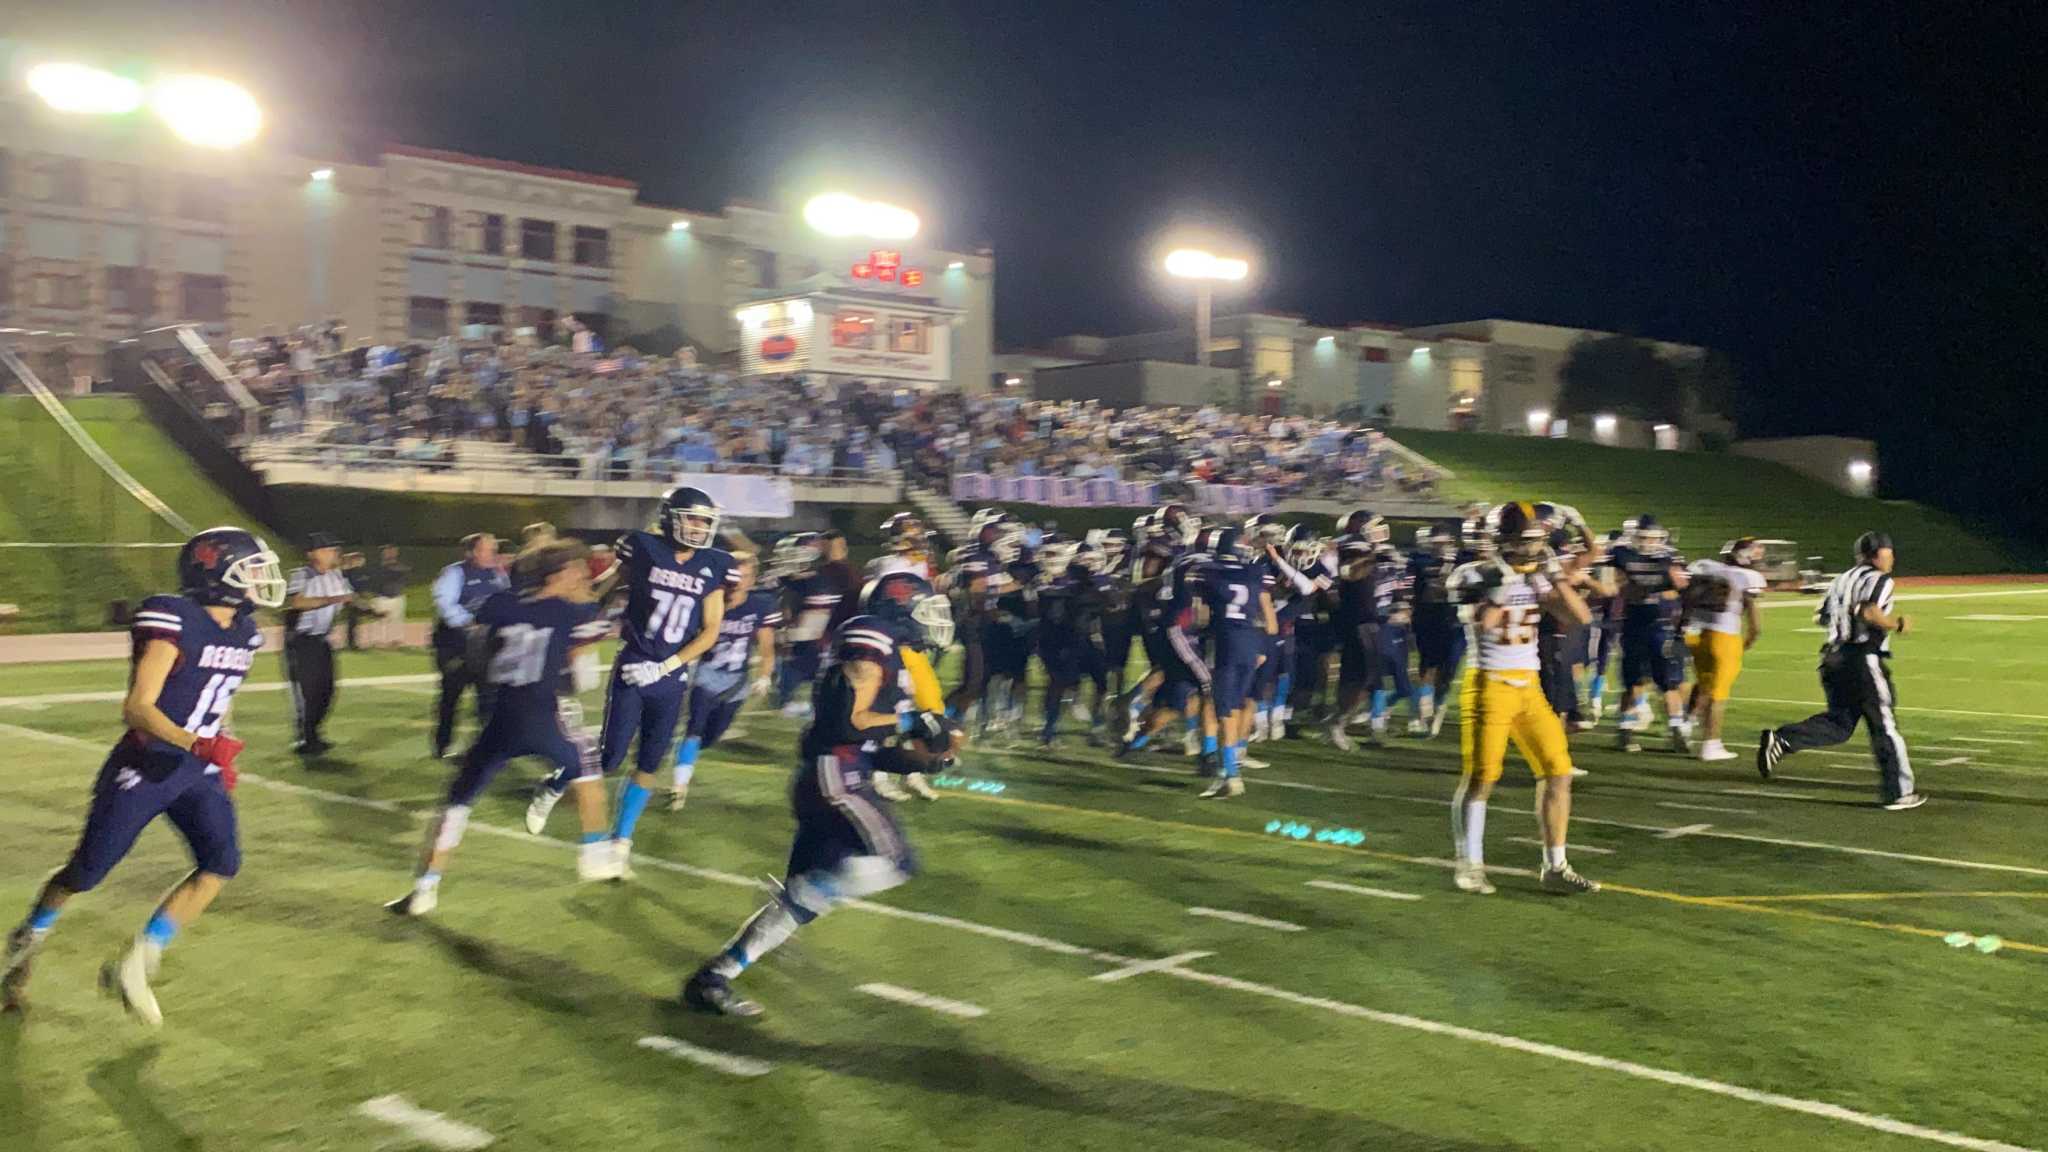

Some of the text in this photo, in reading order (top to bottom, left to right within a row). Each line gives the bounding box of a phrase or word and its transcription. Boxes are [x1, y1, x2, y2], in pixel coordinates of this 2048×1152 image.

[648, 566, 705, 595] REBELS
[644, 589, 695, 643] 70
[1225, 583, 1249, 619] 2
